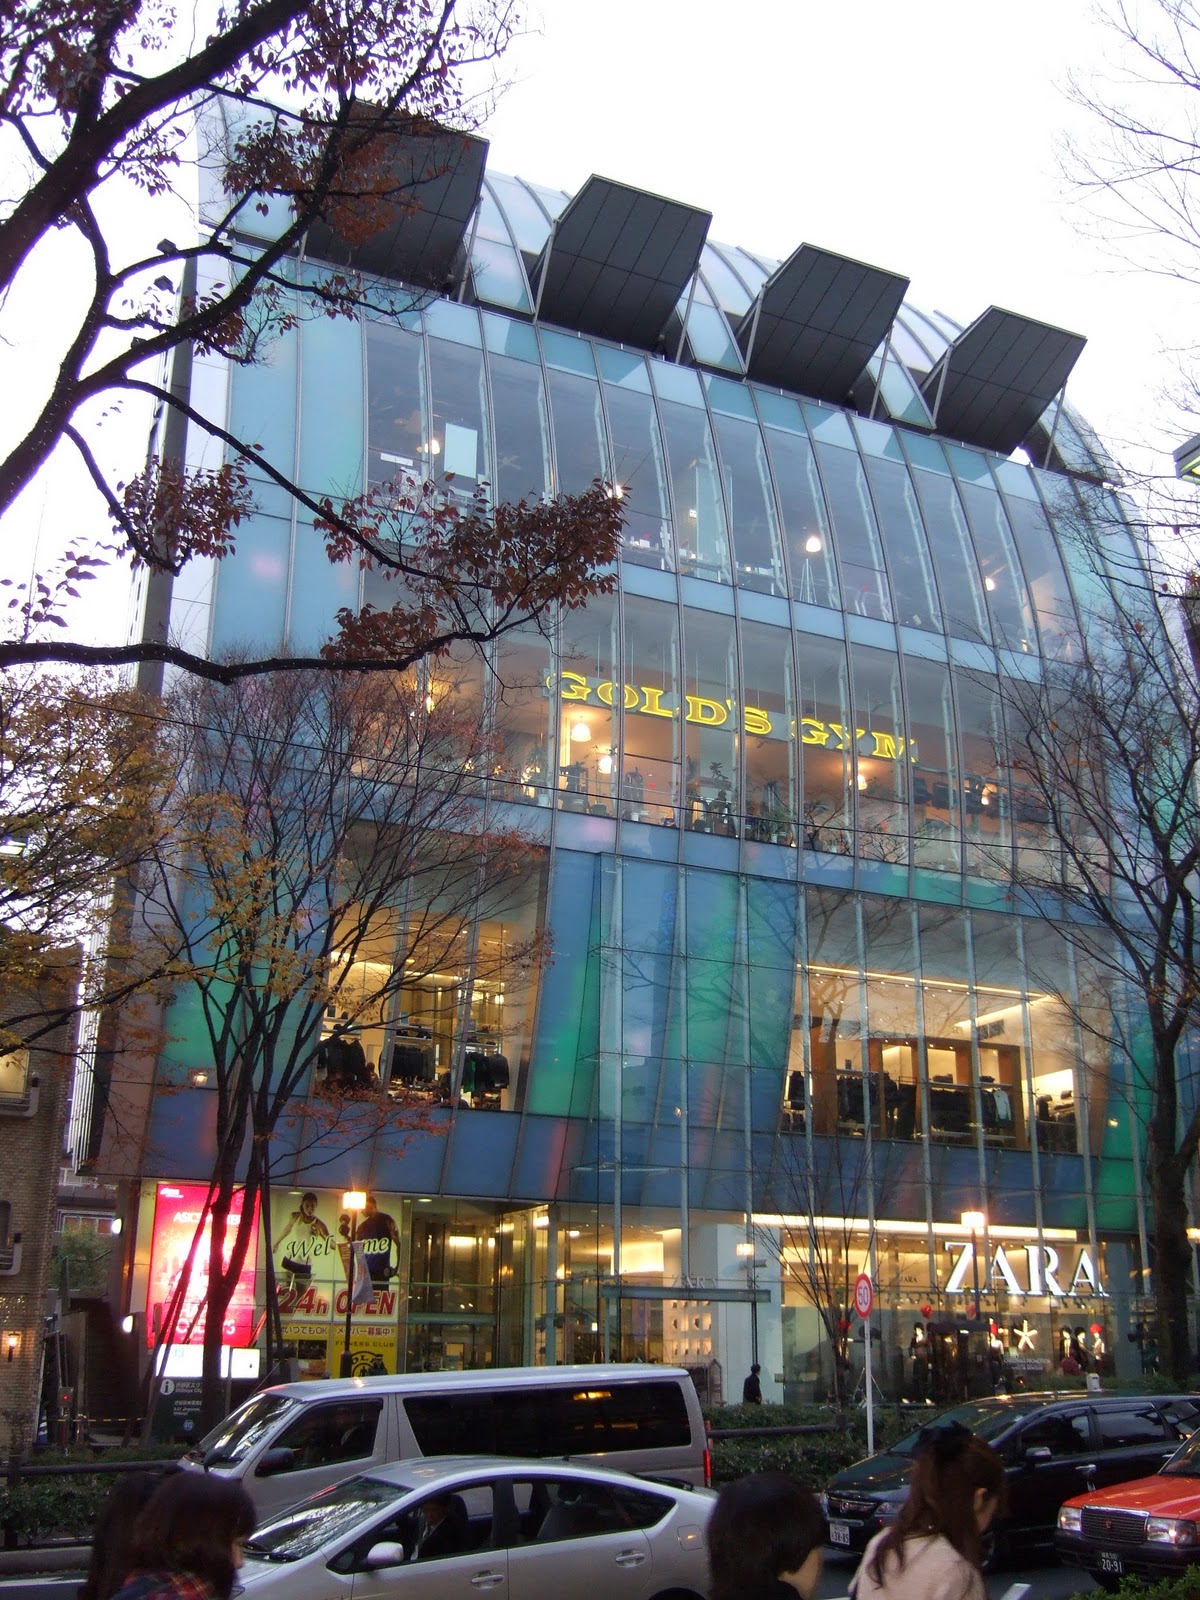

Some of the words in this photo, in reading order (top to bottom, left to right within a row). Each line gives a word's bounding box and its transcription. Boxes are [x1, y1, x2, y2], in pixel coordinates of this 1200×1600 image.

[546, 671, 772, 735] GOLD'S
[791, 718, 919, 763] GYM
[286, 1234, 390, 1260] Welme
[944, 1241, 1111, 1297] ZARA
